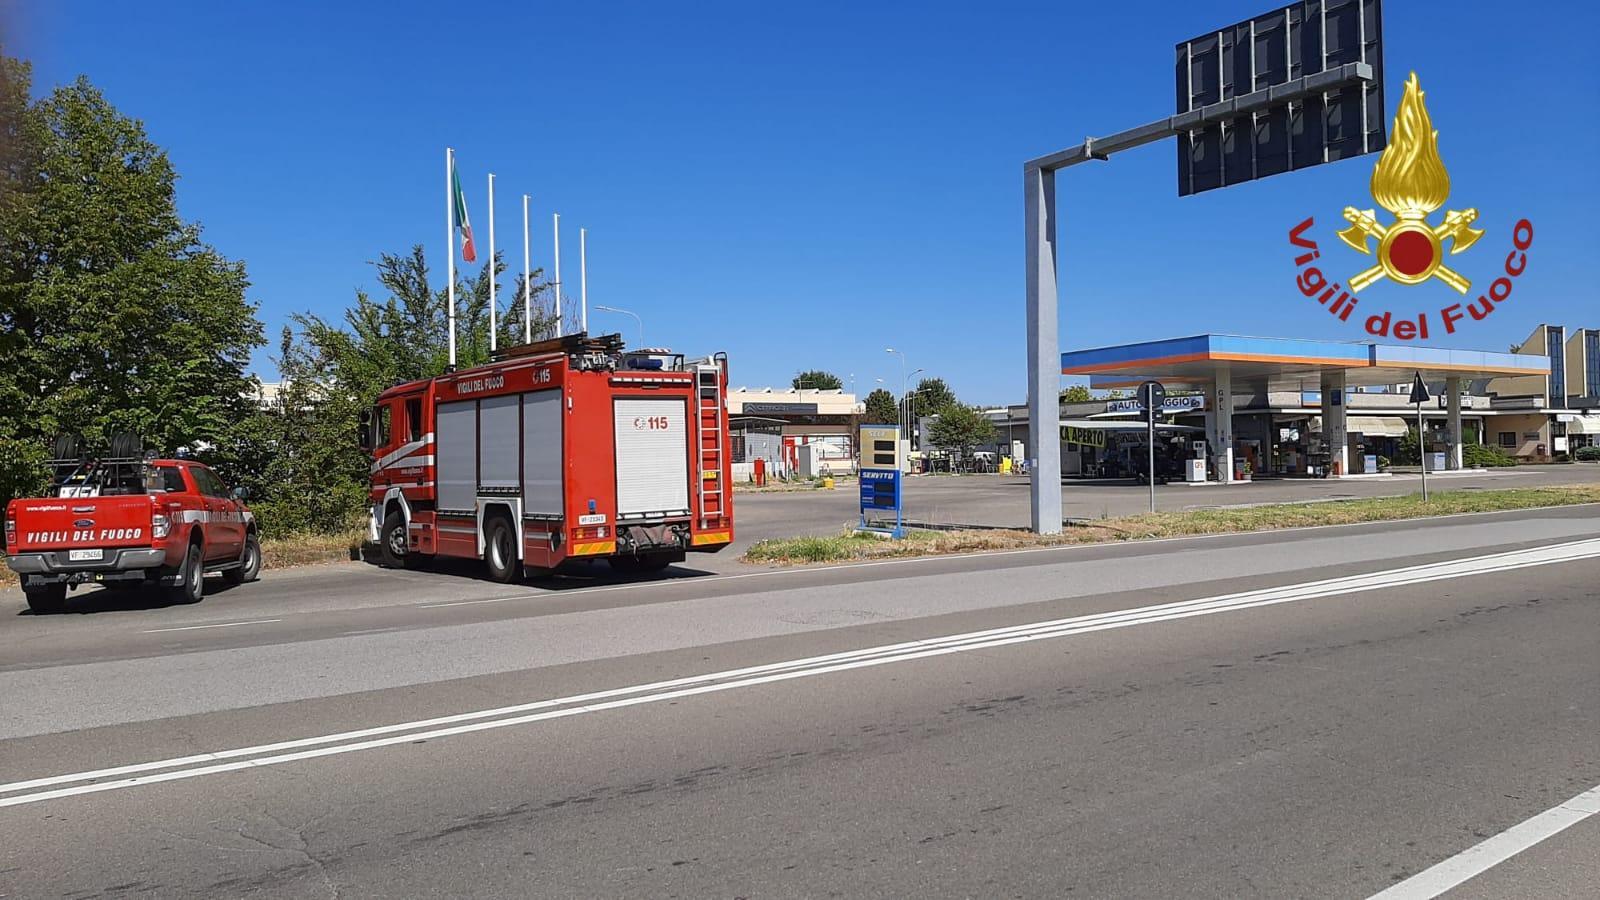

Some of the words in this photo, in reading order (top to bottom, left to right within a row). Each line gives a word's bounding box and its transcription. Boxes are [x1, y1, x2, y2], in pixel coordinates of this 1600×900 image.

[540, 368, 550, 384] 115
[457, 380, 473, 394] VIGILI
[473, 379, 484, 392] DEL
[485, 376, 504, 390] FUOCO
[648, 416, 668, 429] 115
[1072, 426, 1103, 445] APERTO
[862, 472, 894, 480] SERVITO
[27, 531, 68, 543] VIGILI
[72, 530, 95, 541] DEL
[100, 528, 142, 540] FUOCO
[70, 551, 79, 559] VF
